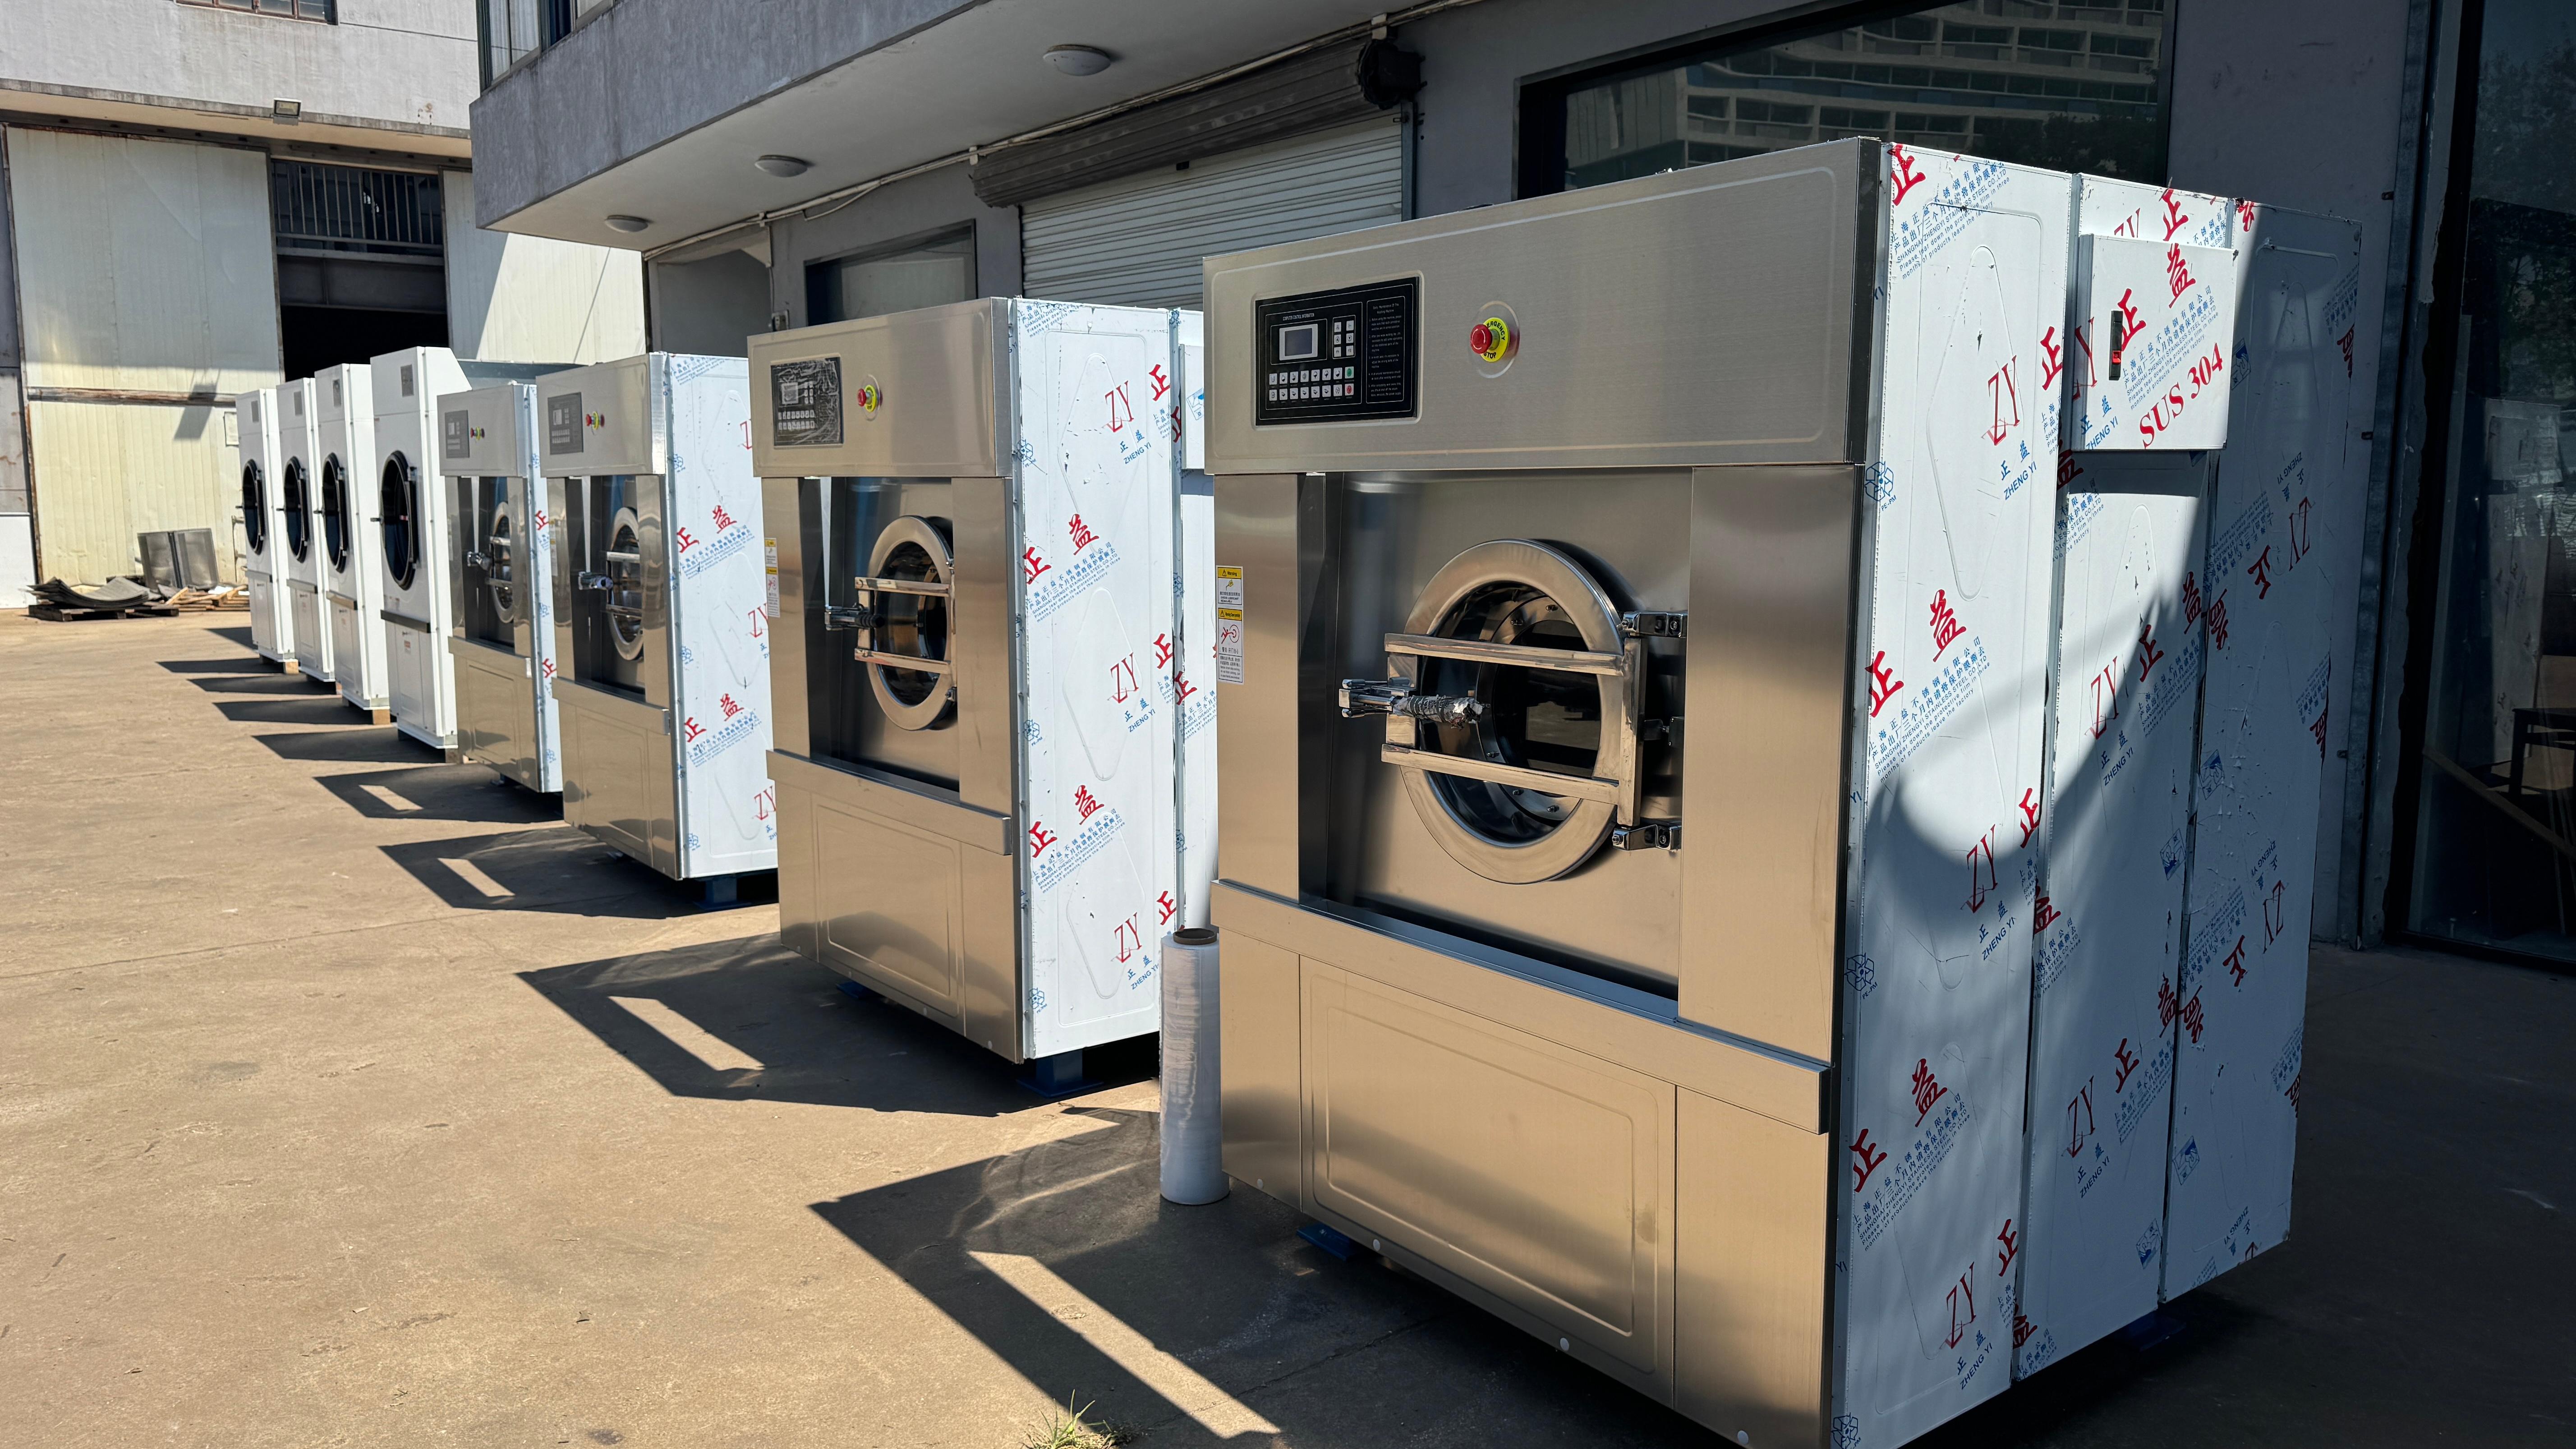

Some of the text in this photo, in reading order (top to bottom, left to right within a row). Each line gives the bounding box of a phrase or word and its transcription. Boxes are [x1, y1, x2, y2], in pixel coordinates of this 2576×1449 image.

[1898, 239, 1923, 263] SHANGHAI
[1922, 220, 1945, 241] ZHENGYI
[1973, 185, 1987, 200] STEEL
[1487, 321, 1505, 340] ERGENCY
[2127, 373, 2147, 396] SHANGHAI
[2148, 355, 2165, 375] ZHENGYI
[2166, 333, 2187, 356] STAINLESS
[2188, 322, 2200, 335] STEEL
[1105, 381, 1134, 432] ZY
[1988, 356, 2020, 446] ZY
[2139, 343, 2223, 448] SUS 304
[1124, 447, 1144, 464] ZHENG
[2086, 416, 2118, 450] ZHENG YI
[1881, 495, 1896, 511] PE-PM
[2004, 461, 2037, 500] ZHENG YI
[2071, 516, 2084, 530] STEEL
[1109, 652, 1140, 704] ZY
[2091, 656, 2118, 740] ZY
[1128, 714, 1149, 732] ZHENG
[1875, 741, 1901, 768] SHANGHAI
[1902, 718, 1924, 742] ZHENGYI
[1925, 691, 1951, 719] STAINLESS
[1953, 676, 1968, 692] STEEL
[1878, 757, 1895, 776] Please
[1897, 745, 1907, 756] tear
[1910, 730, 1923, 744] down
[1924, 720, 1932, 730] the
[1934, 694, 1959, 721] protective
[1961, 683, 1970, 693] film
[1978, 662, 1989, 676] three
[1881, 763, 1899, 783] months
[1908, 732, 1930, 756] products
[1931, 717, 1945, 731] leave
[1956, 688, 1973, 707] factory
[2103, 747, 2134, 786] ZHENG YI
[1968, 824, 1996, 913] ZY
[1114, 913, 1142, 963] ZY
[1982, 917, 2016, 961] ZHENG YI
[1131, 971, 1151, 990] ZHENG
[1862, 982, 1877, 999] PE-PM
[2067, 1076, 2095, 1158] ZY
[2080, 1156, 2109, 1198] ZHENG YI
[1946, 1262, 1974, 1348] ZY
[1960, 1343, 1992, 1389] ZHENG YI
